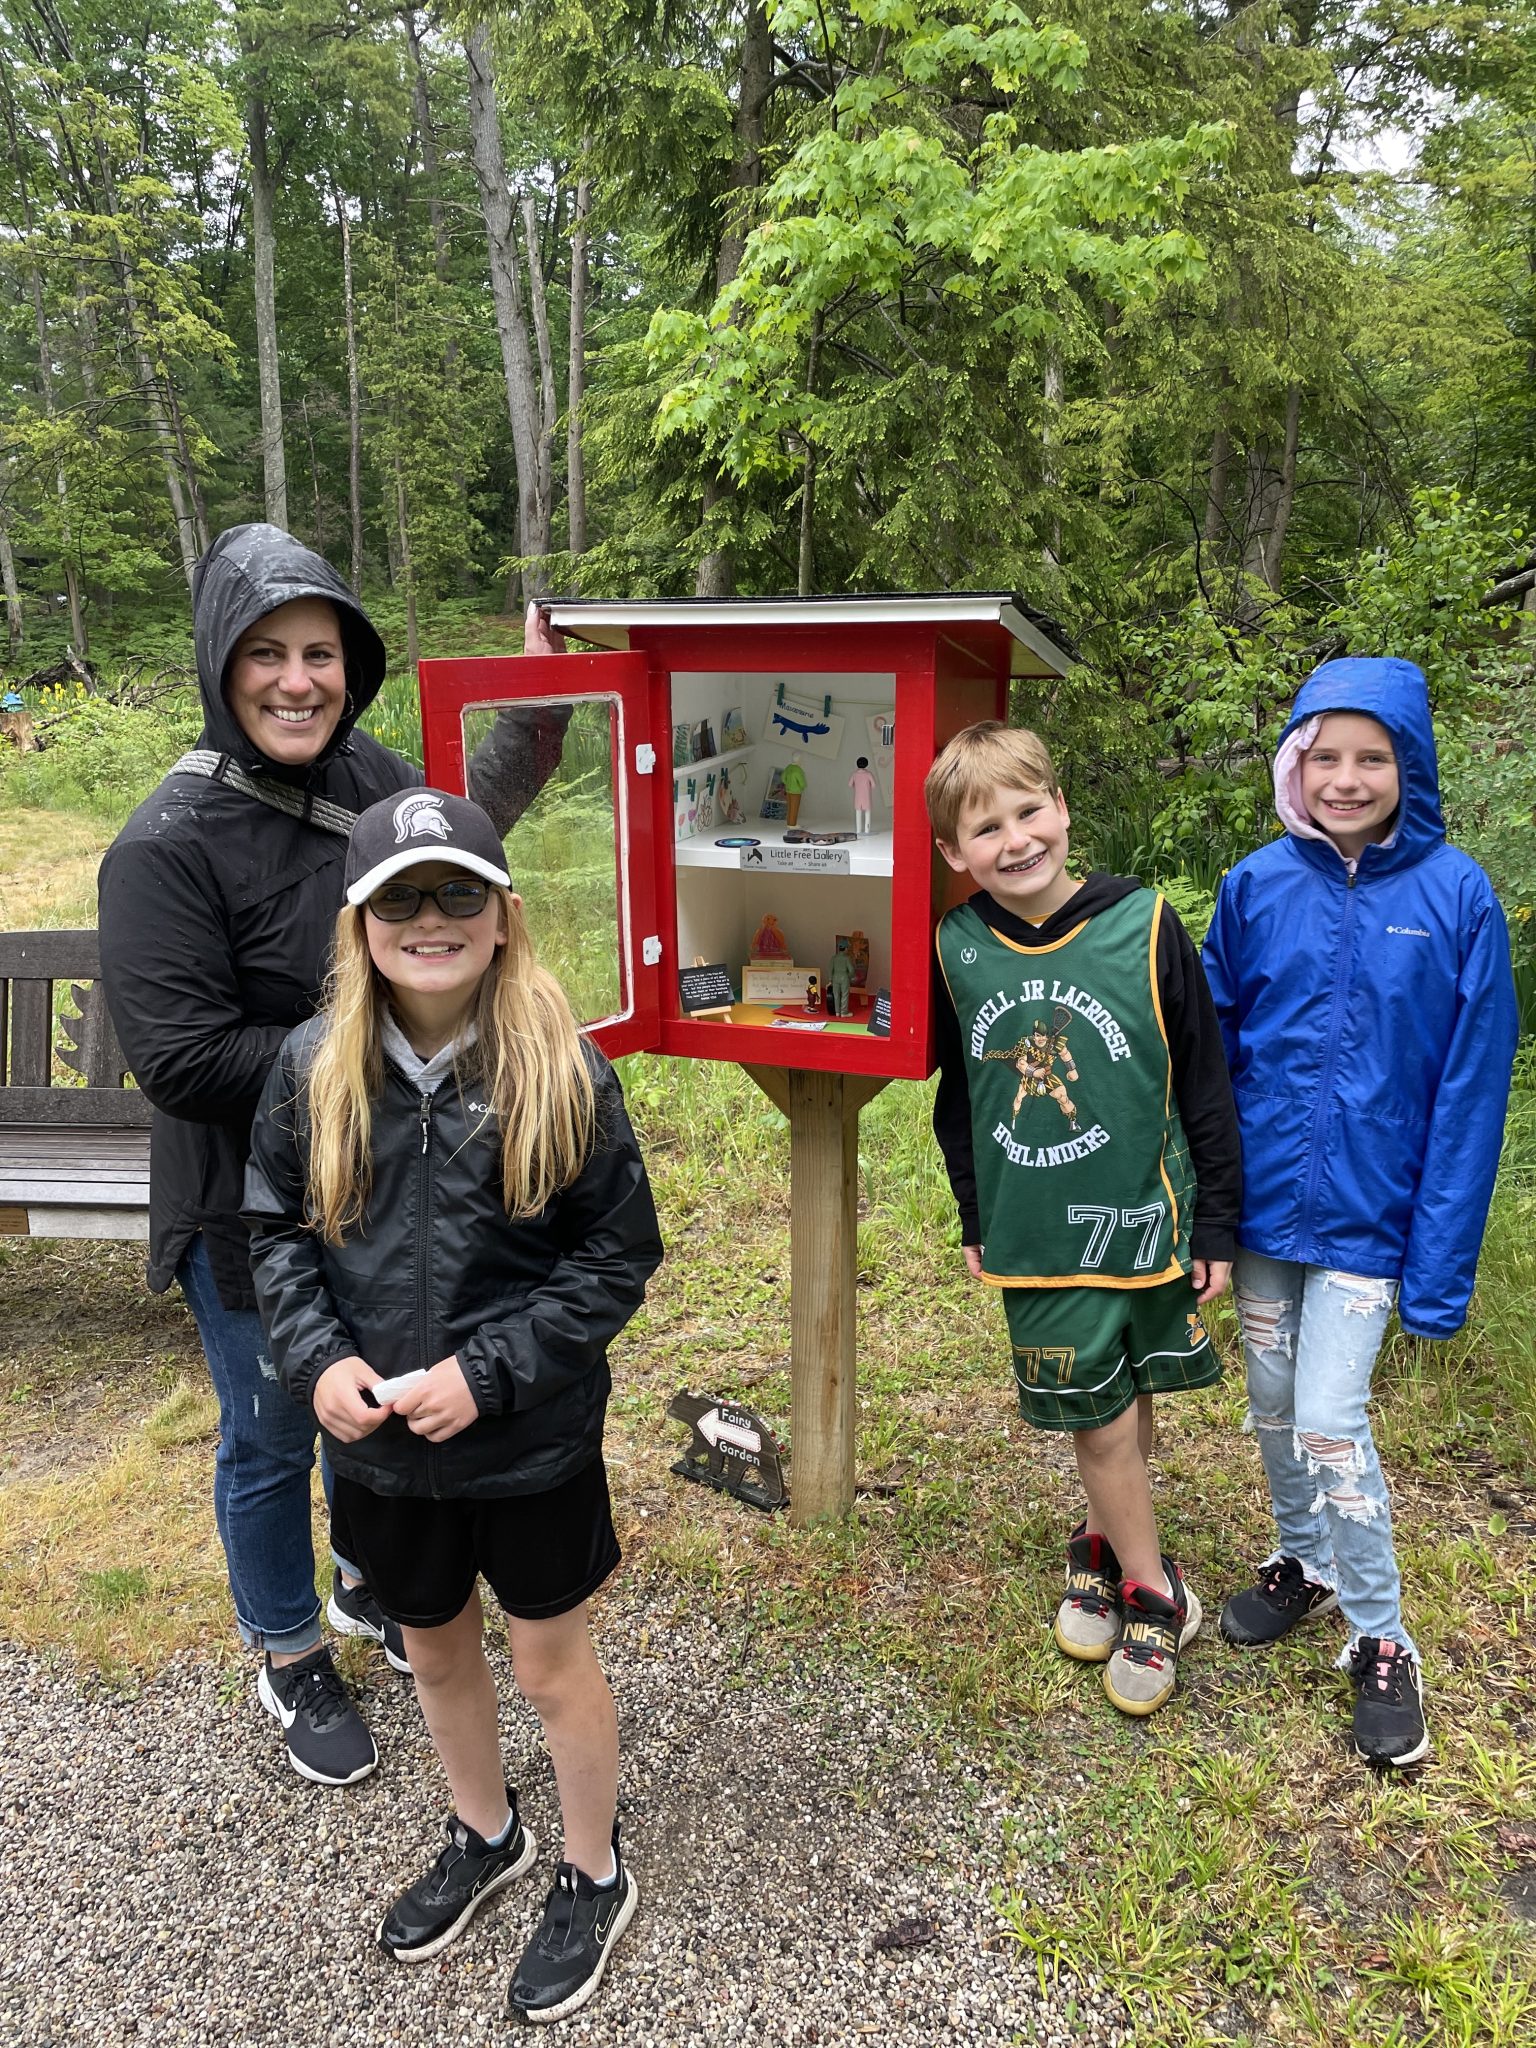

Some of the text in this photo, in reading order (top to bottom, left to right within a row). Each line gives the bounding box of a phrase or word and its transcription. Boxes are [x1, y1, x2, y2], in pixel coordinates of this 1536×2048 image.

[770, 849, 792, 859] Little
[793, 850, 812, 860] Free
[1394, 926, 1431, 938] Columbia
[971, 990, 1017, 1061] HOWELL
[1019, 979, 1045, 1003] JR
[1049, 980, 1132, 1062] LACROSSE
[991, 1121, 1111, 1168] HIHLANDERS
[1067, 1201, 1166, 1270] 77
[1013, 1344, 1076, 1385] 77
[721, 1408, 752, 1429] Fairy
[719, 1440, 761, 1467] Garden
[1064, 1572, 1118, 1603] NIKE
[1122, 1622, 1176, 1654] NIKE
